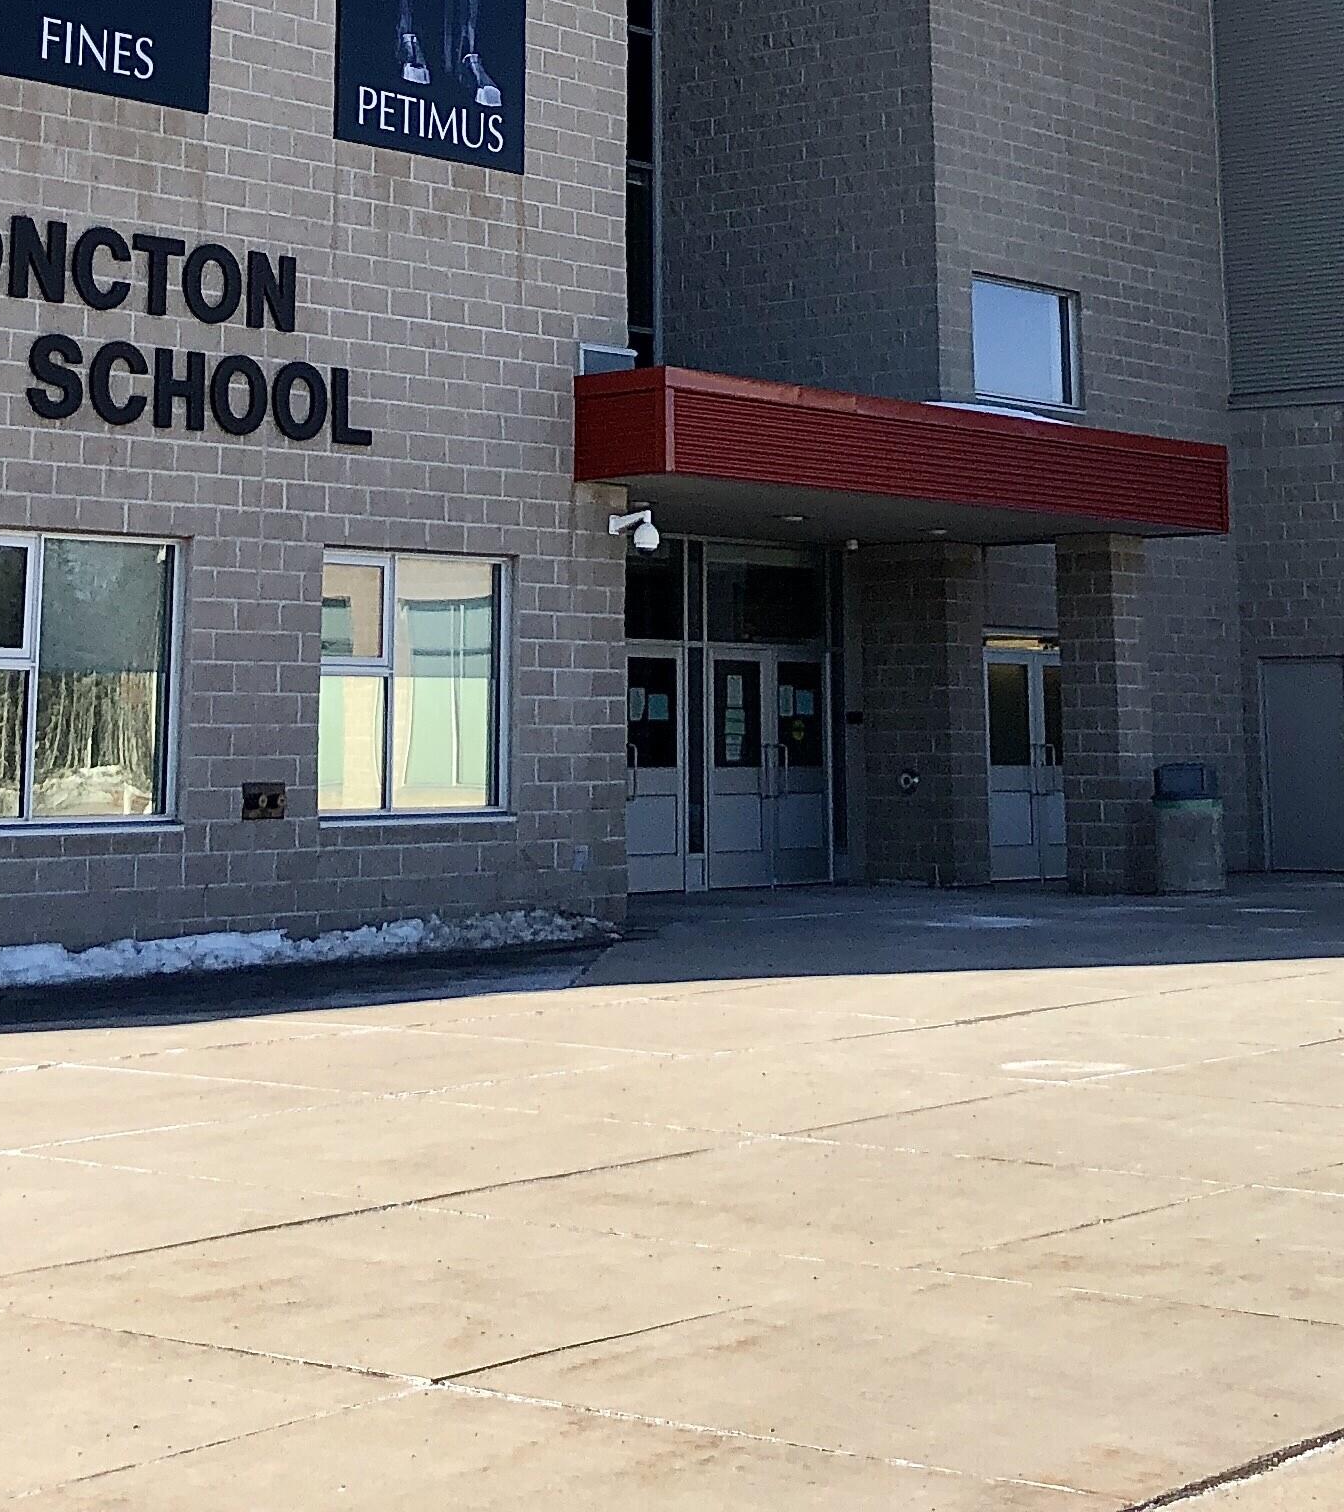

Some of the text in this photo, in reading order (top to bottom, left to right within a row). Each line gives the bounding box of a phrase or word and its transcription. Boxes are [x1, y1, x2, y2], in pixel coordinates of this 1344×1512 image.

[41, 16, 154, 80] FINES
[358, 85, 504, 153] PETIMUS
[26, 333, 373, 447] SCHOOL
